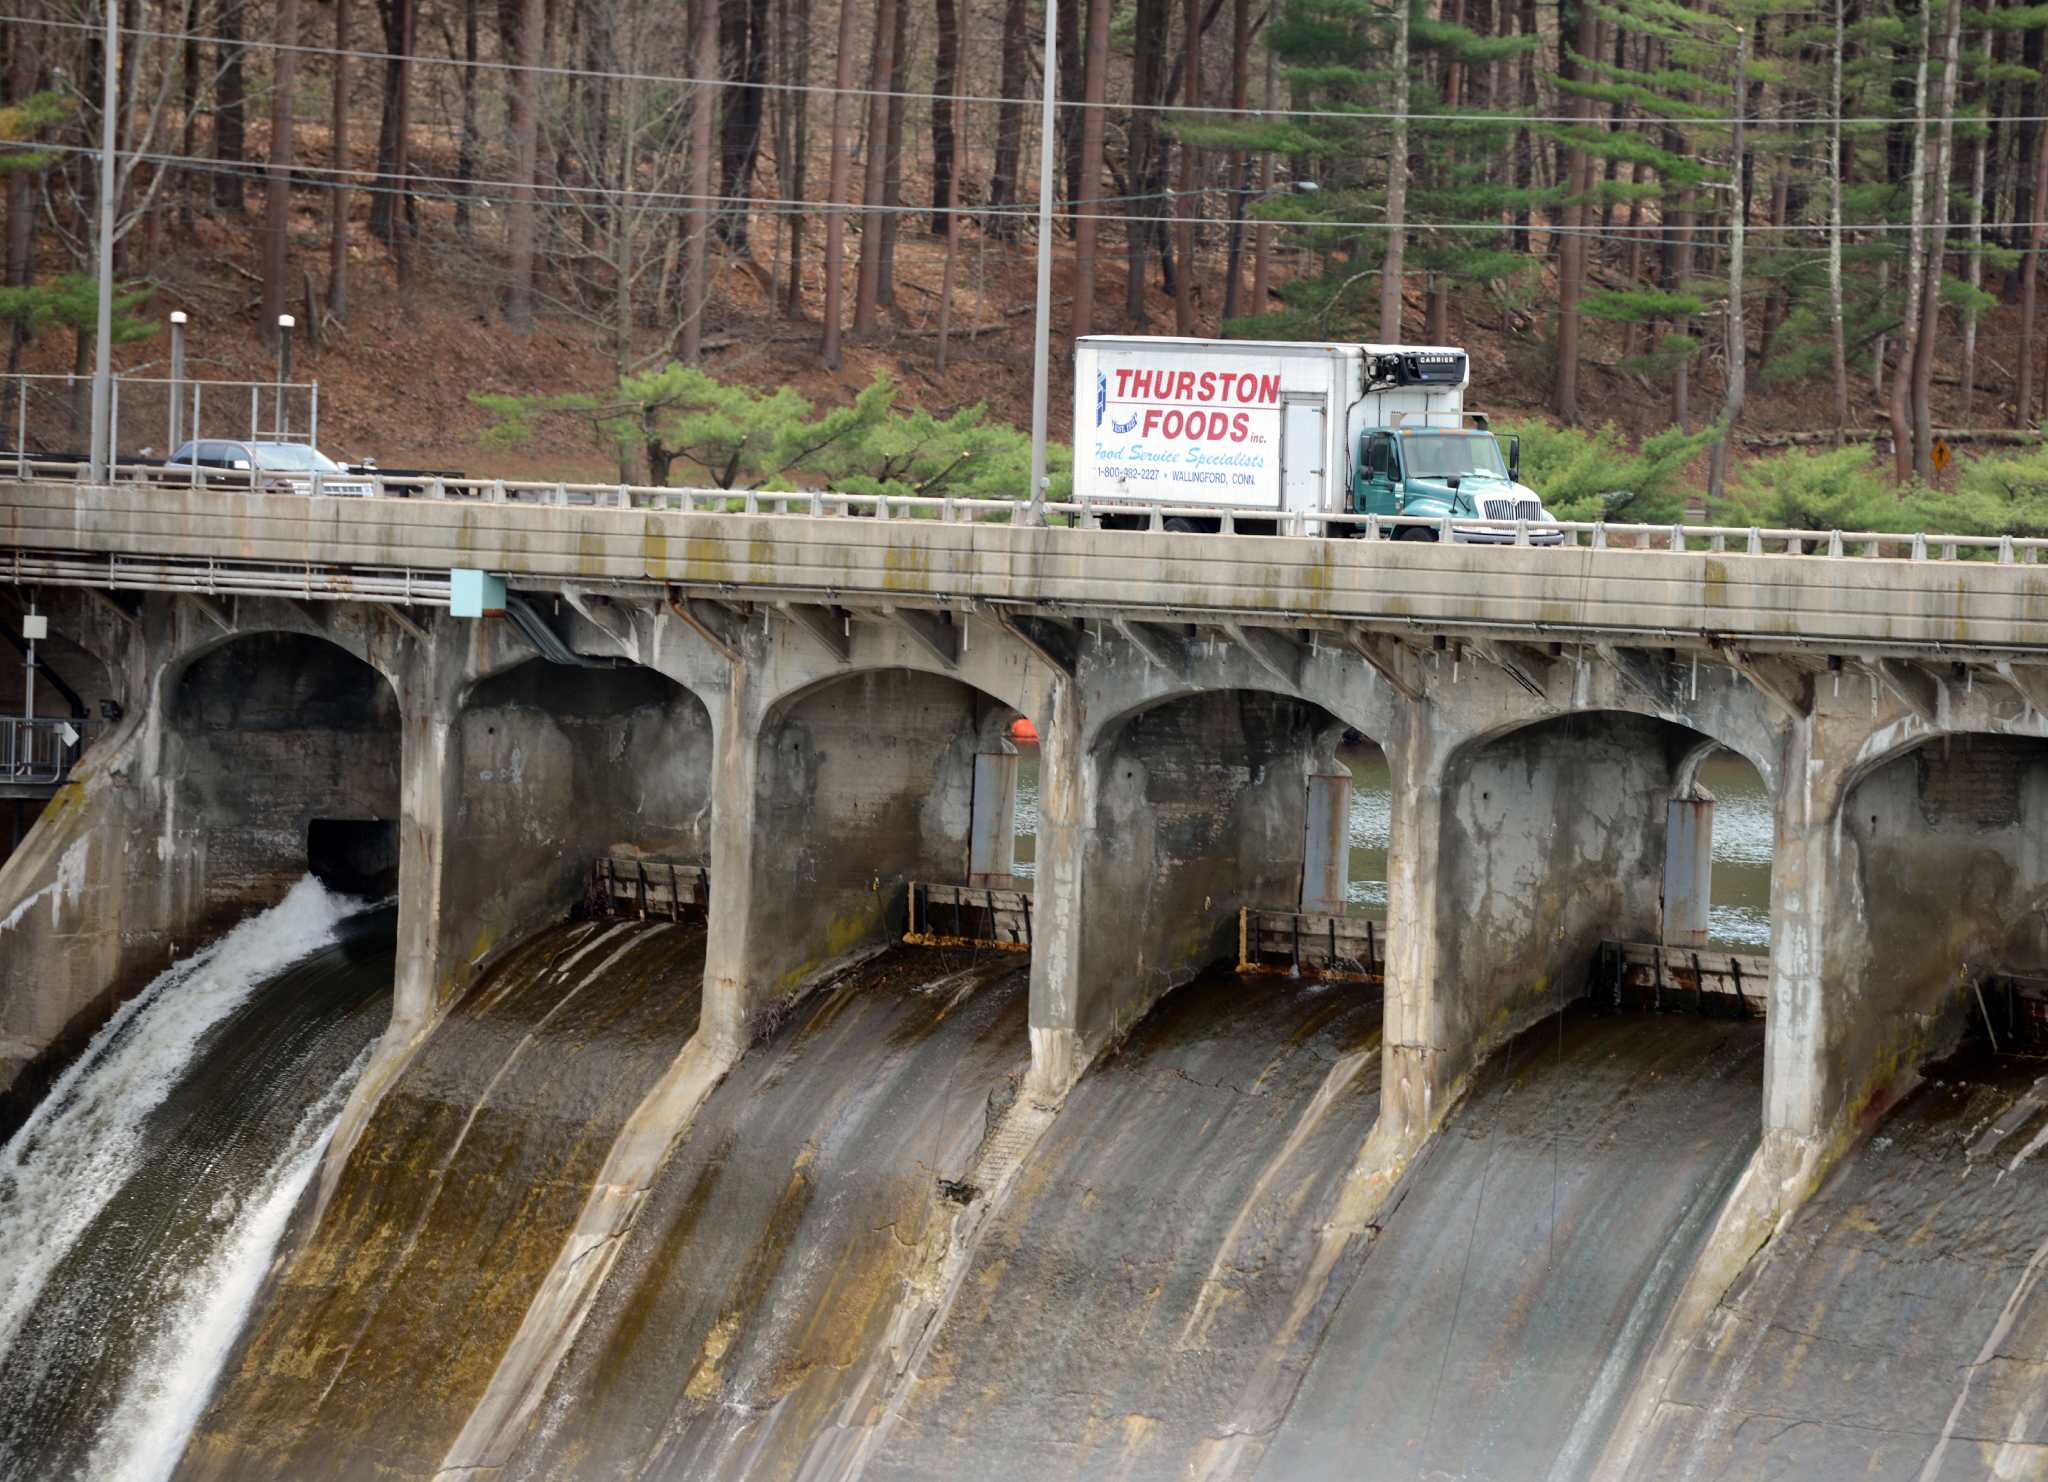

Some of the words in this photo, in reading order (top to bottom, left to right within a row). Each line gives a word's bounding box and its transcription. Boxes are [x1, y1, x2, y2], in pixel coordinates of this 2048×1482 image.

[1420, 356, 1455, 364] CARRIER
[1115, 368, 1281, 404] THURSTON
[1141, 409, 1251, 443] FOODS
[1250, 431, 1268, 444] inc.
[1129, 444, 1180, 462] Service
[1185, 447, 1265, 468] Specialists
